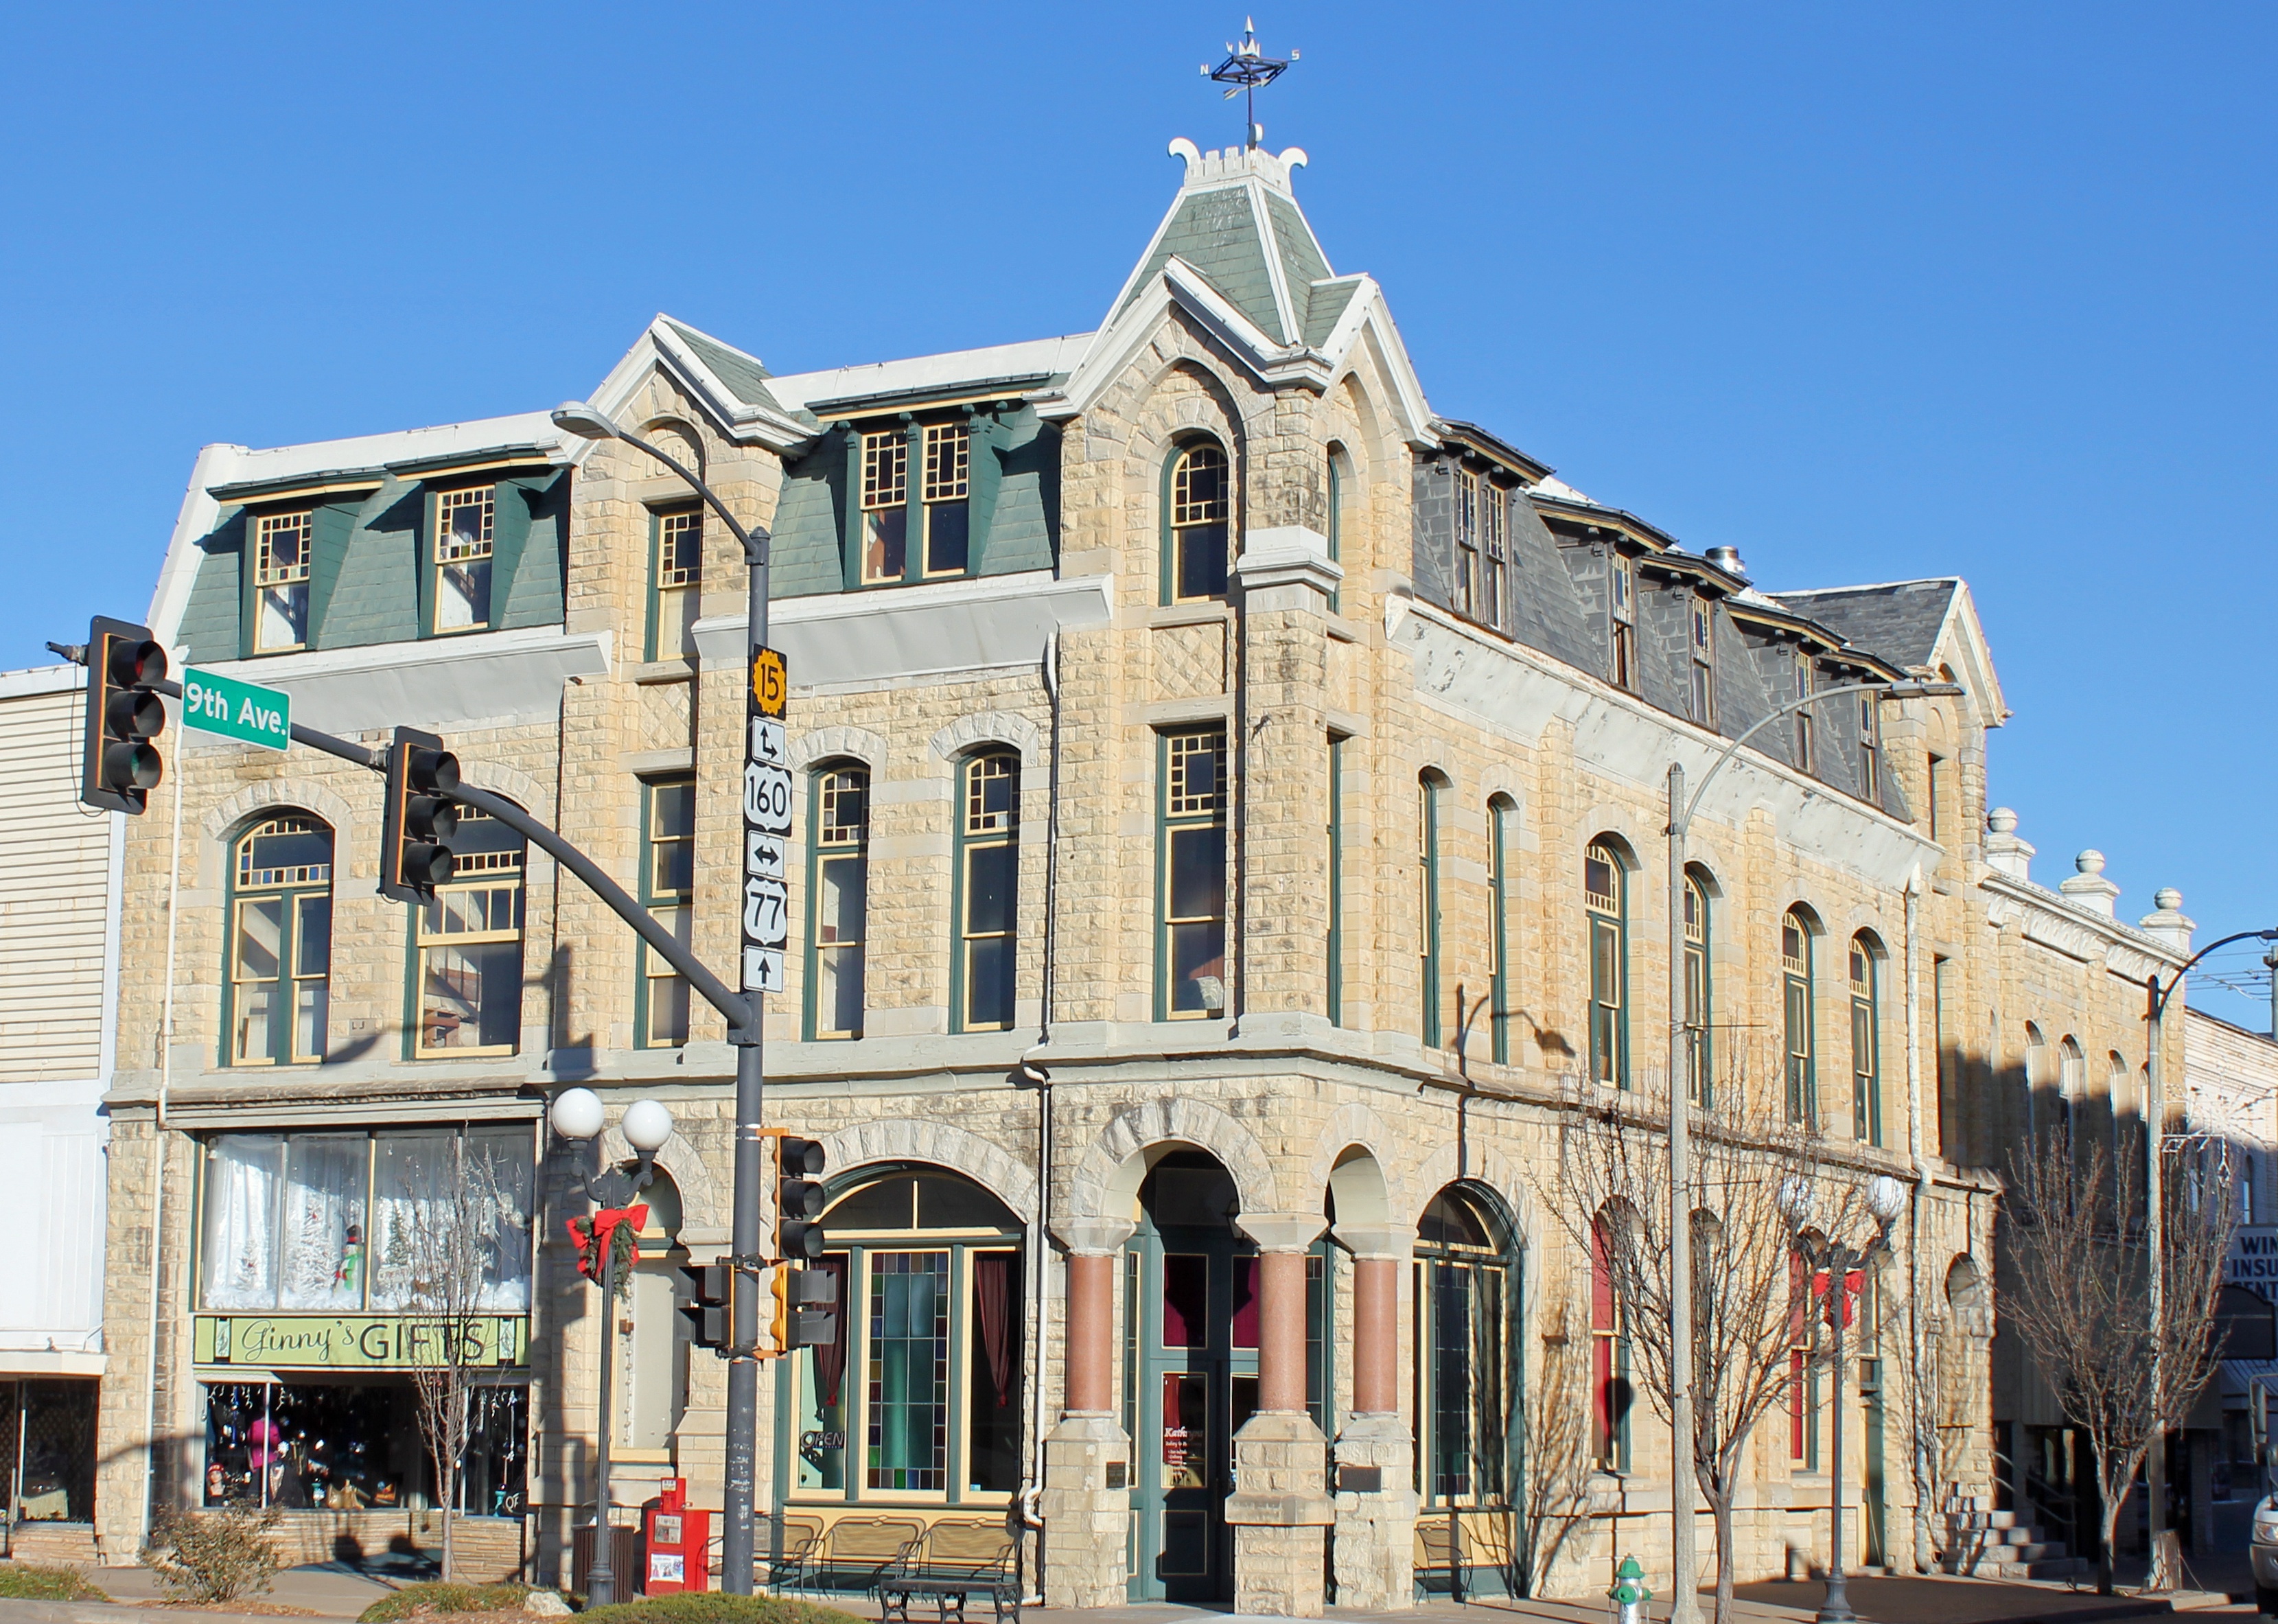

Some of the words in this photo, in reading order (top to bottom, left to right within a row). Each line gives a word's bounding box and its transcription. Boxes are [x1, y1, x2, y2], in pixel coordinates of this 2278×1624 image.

[1226, 42, 1233, 53] W
[1291, 49, 1300, 60] S
[1200, 65, 1209, 76] N
[761, 663, 780, 701] 15
[187, 682, 229, 721] 9th
[237, 697, 286, 736] Ave.
[749, 775, 787, 817] 160
[750, 892, 782, 931] 77
[242, 1319, 355, 1362] Ginny's
[360, 1323, 485, 1360] GIFTS
[801, 1432, 844, 1448] OPEN
